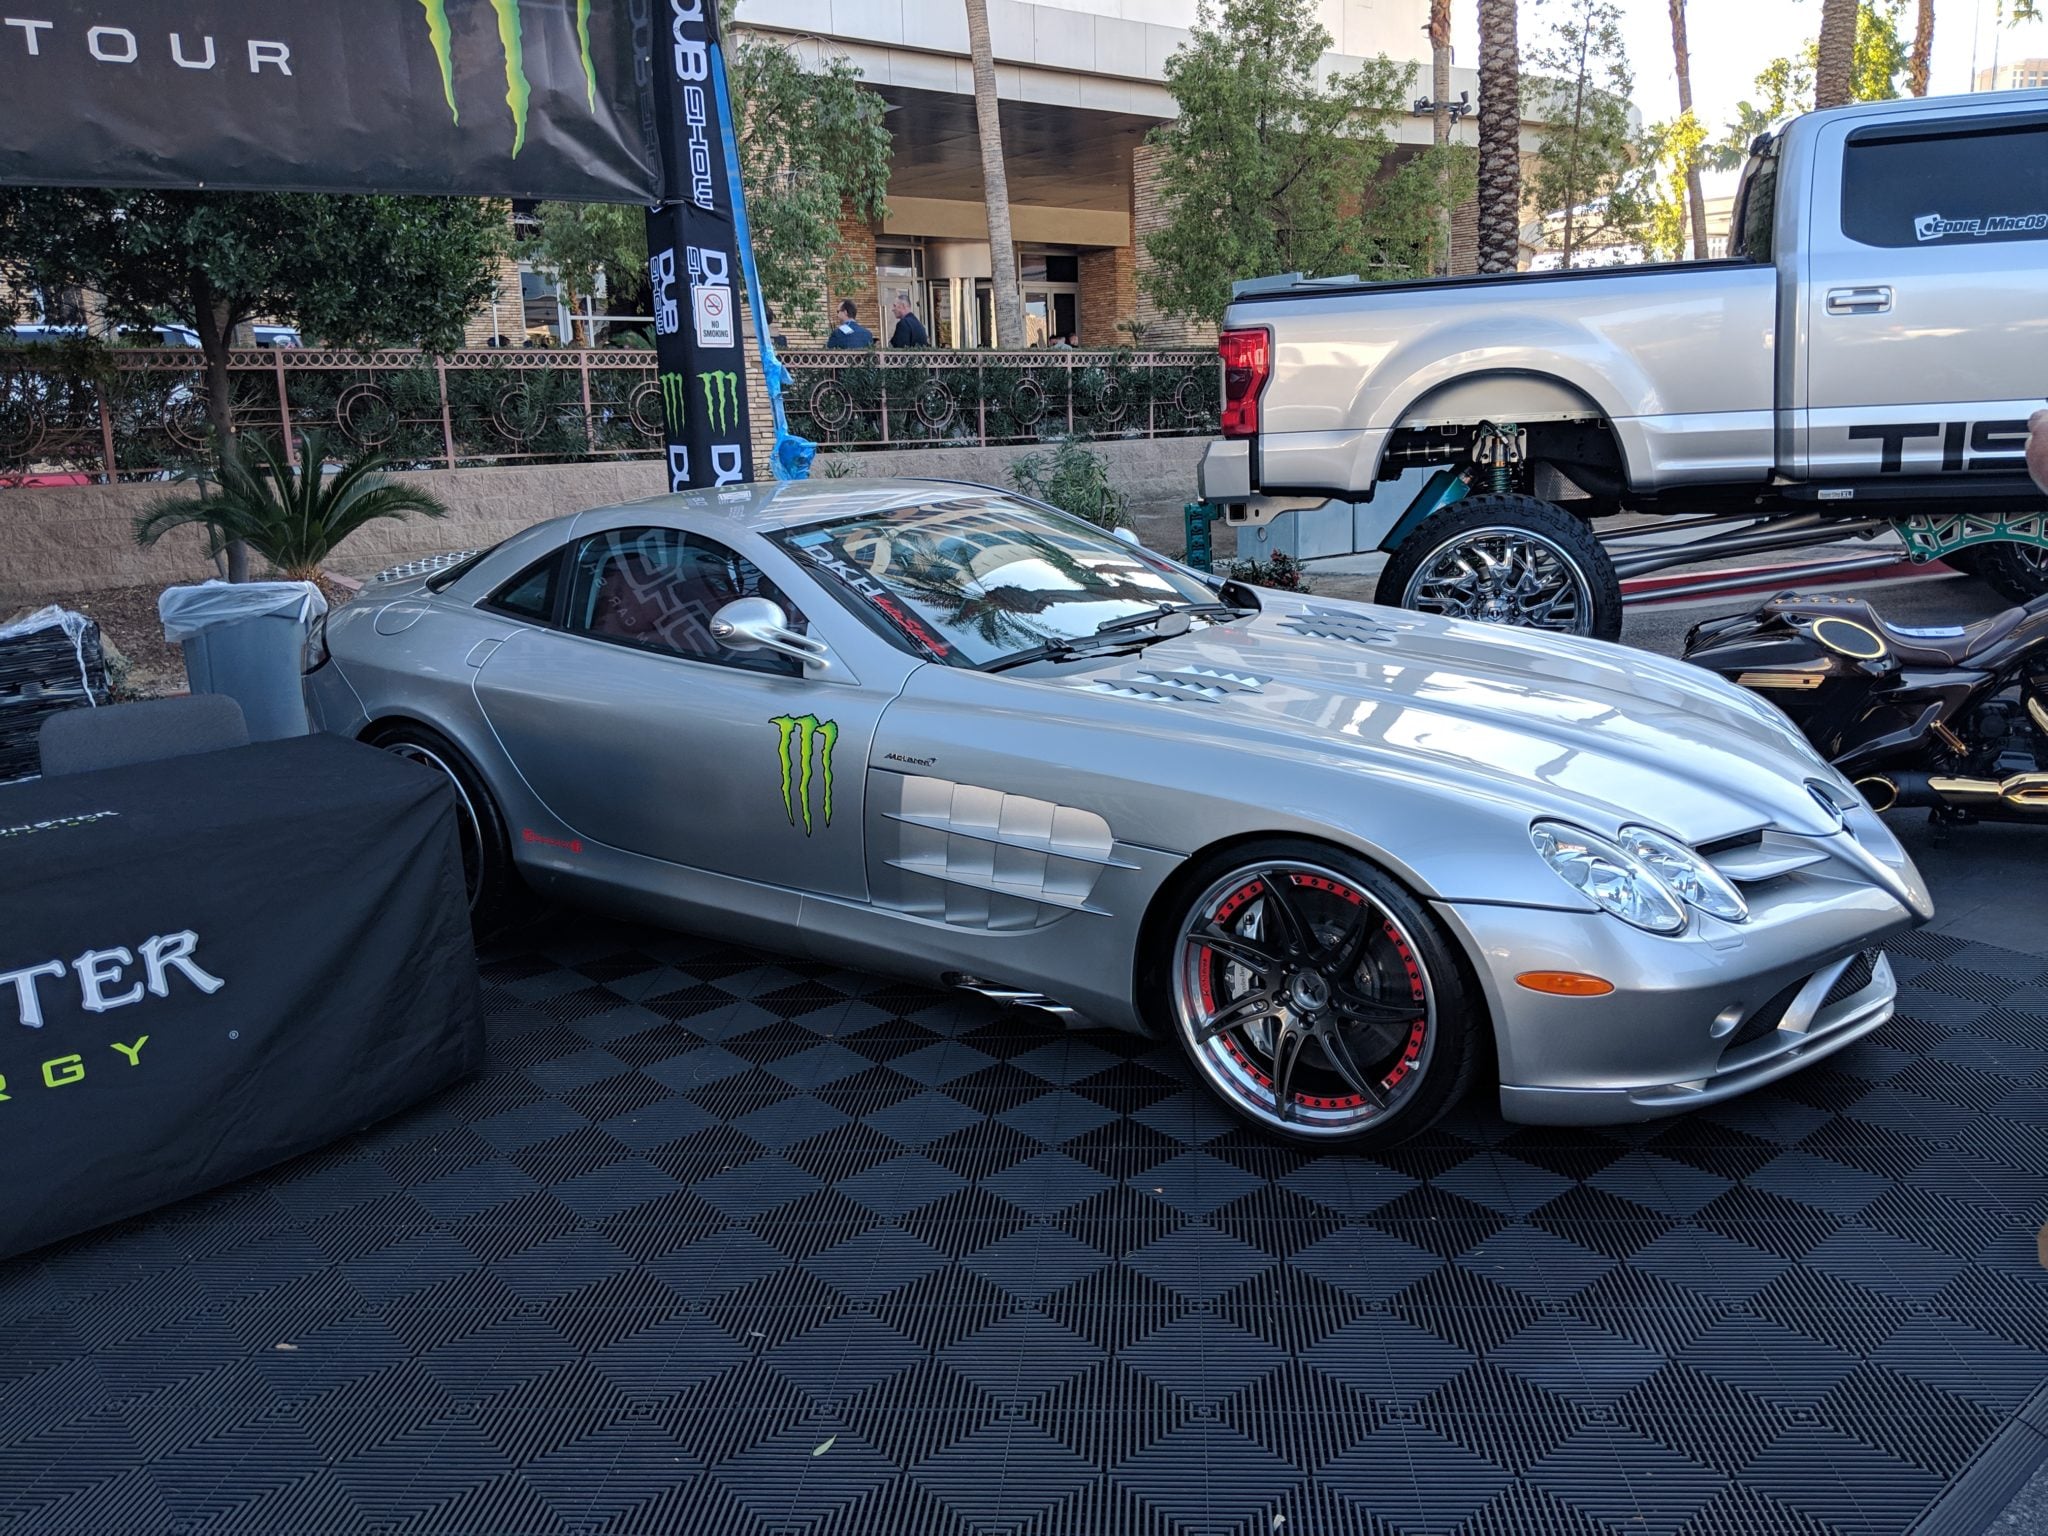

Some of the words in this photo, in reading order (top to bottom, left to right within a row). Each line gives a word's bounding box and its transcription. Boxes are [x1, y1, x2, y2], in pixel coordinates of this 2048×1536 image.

[4, 18, 292, 76] TOUR
[684, 86, 714, 210] SHOW
[650, 256, 665, 335] SHOW
[658, 248, 679, 334] DUB
[703, 329, 729, 338] SMOKING
[711, 320, 720, 328] NO
[803, 545, 886, 598] DKH
[885, 752, 932, 767] McLaren
[0, 929, 225, 1028] TER
[0, 1035, 149, 1102] GY
